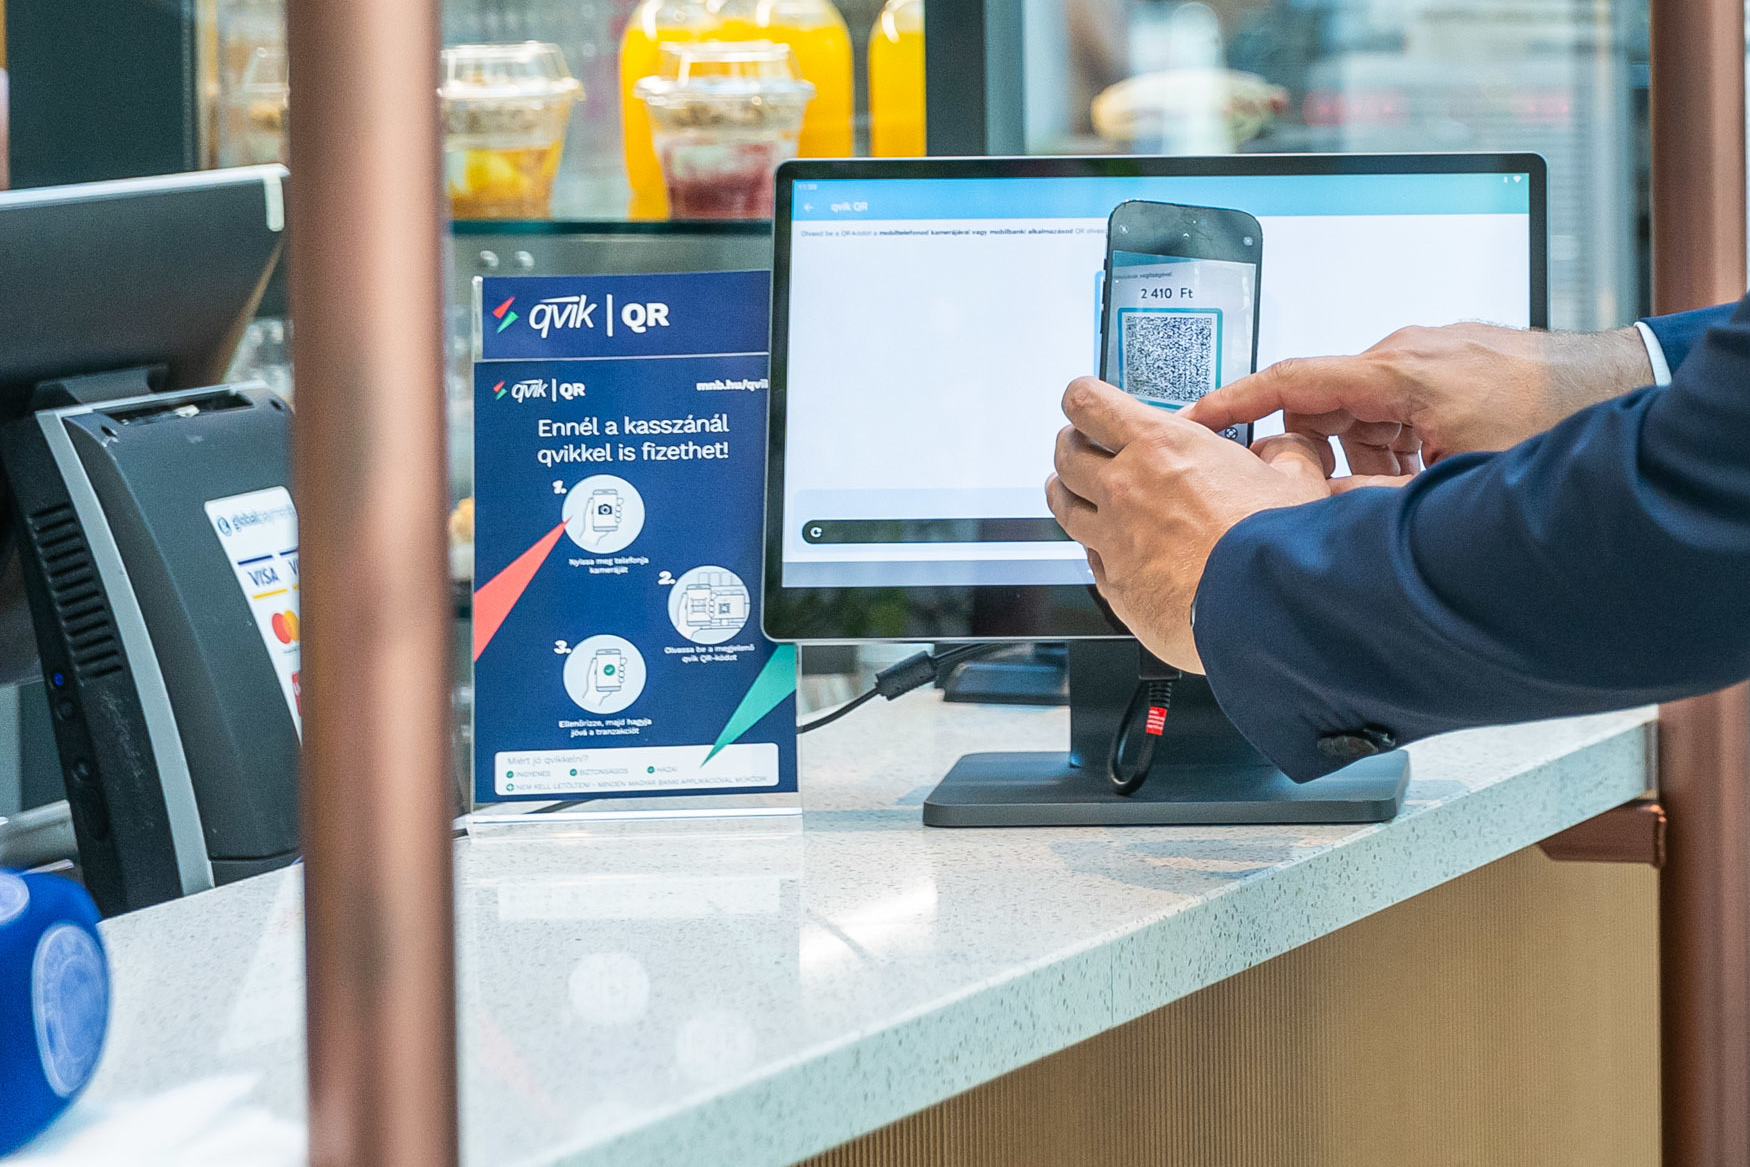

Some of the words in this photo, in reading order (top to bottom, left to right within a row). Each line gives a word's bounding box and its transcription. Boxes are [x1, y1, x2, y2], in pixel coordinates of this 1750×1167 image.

[853, 201, 869, 212] QR
[1141, 288, 1148, 299] 2
[1151, 287, 1173, 299] 410
[1180, 287, 1194, 299] Ft
[528, 294, 598, 338] qvik
[621, 302, 670, 333] QR
[511, 379, 548, 403] qvik
[559, 382, 586, 400] QR
[537, 416, 599, 438] Ennél
[604, 422, 618, 435] a
[624, 413, 730, 436] kasszánál
[537, 443, 611, 467] qvikkel
[618, 442, 636, 462] is
[641, 441, 729, 461] fizethet!
[596, 558, 613, 567] meg
[248, 566, 280, 587] VISA
[657, 570, 676, 585] 2.
[553, 640, 571, 654] 3.
[681, 654, 700, 664] qvik
